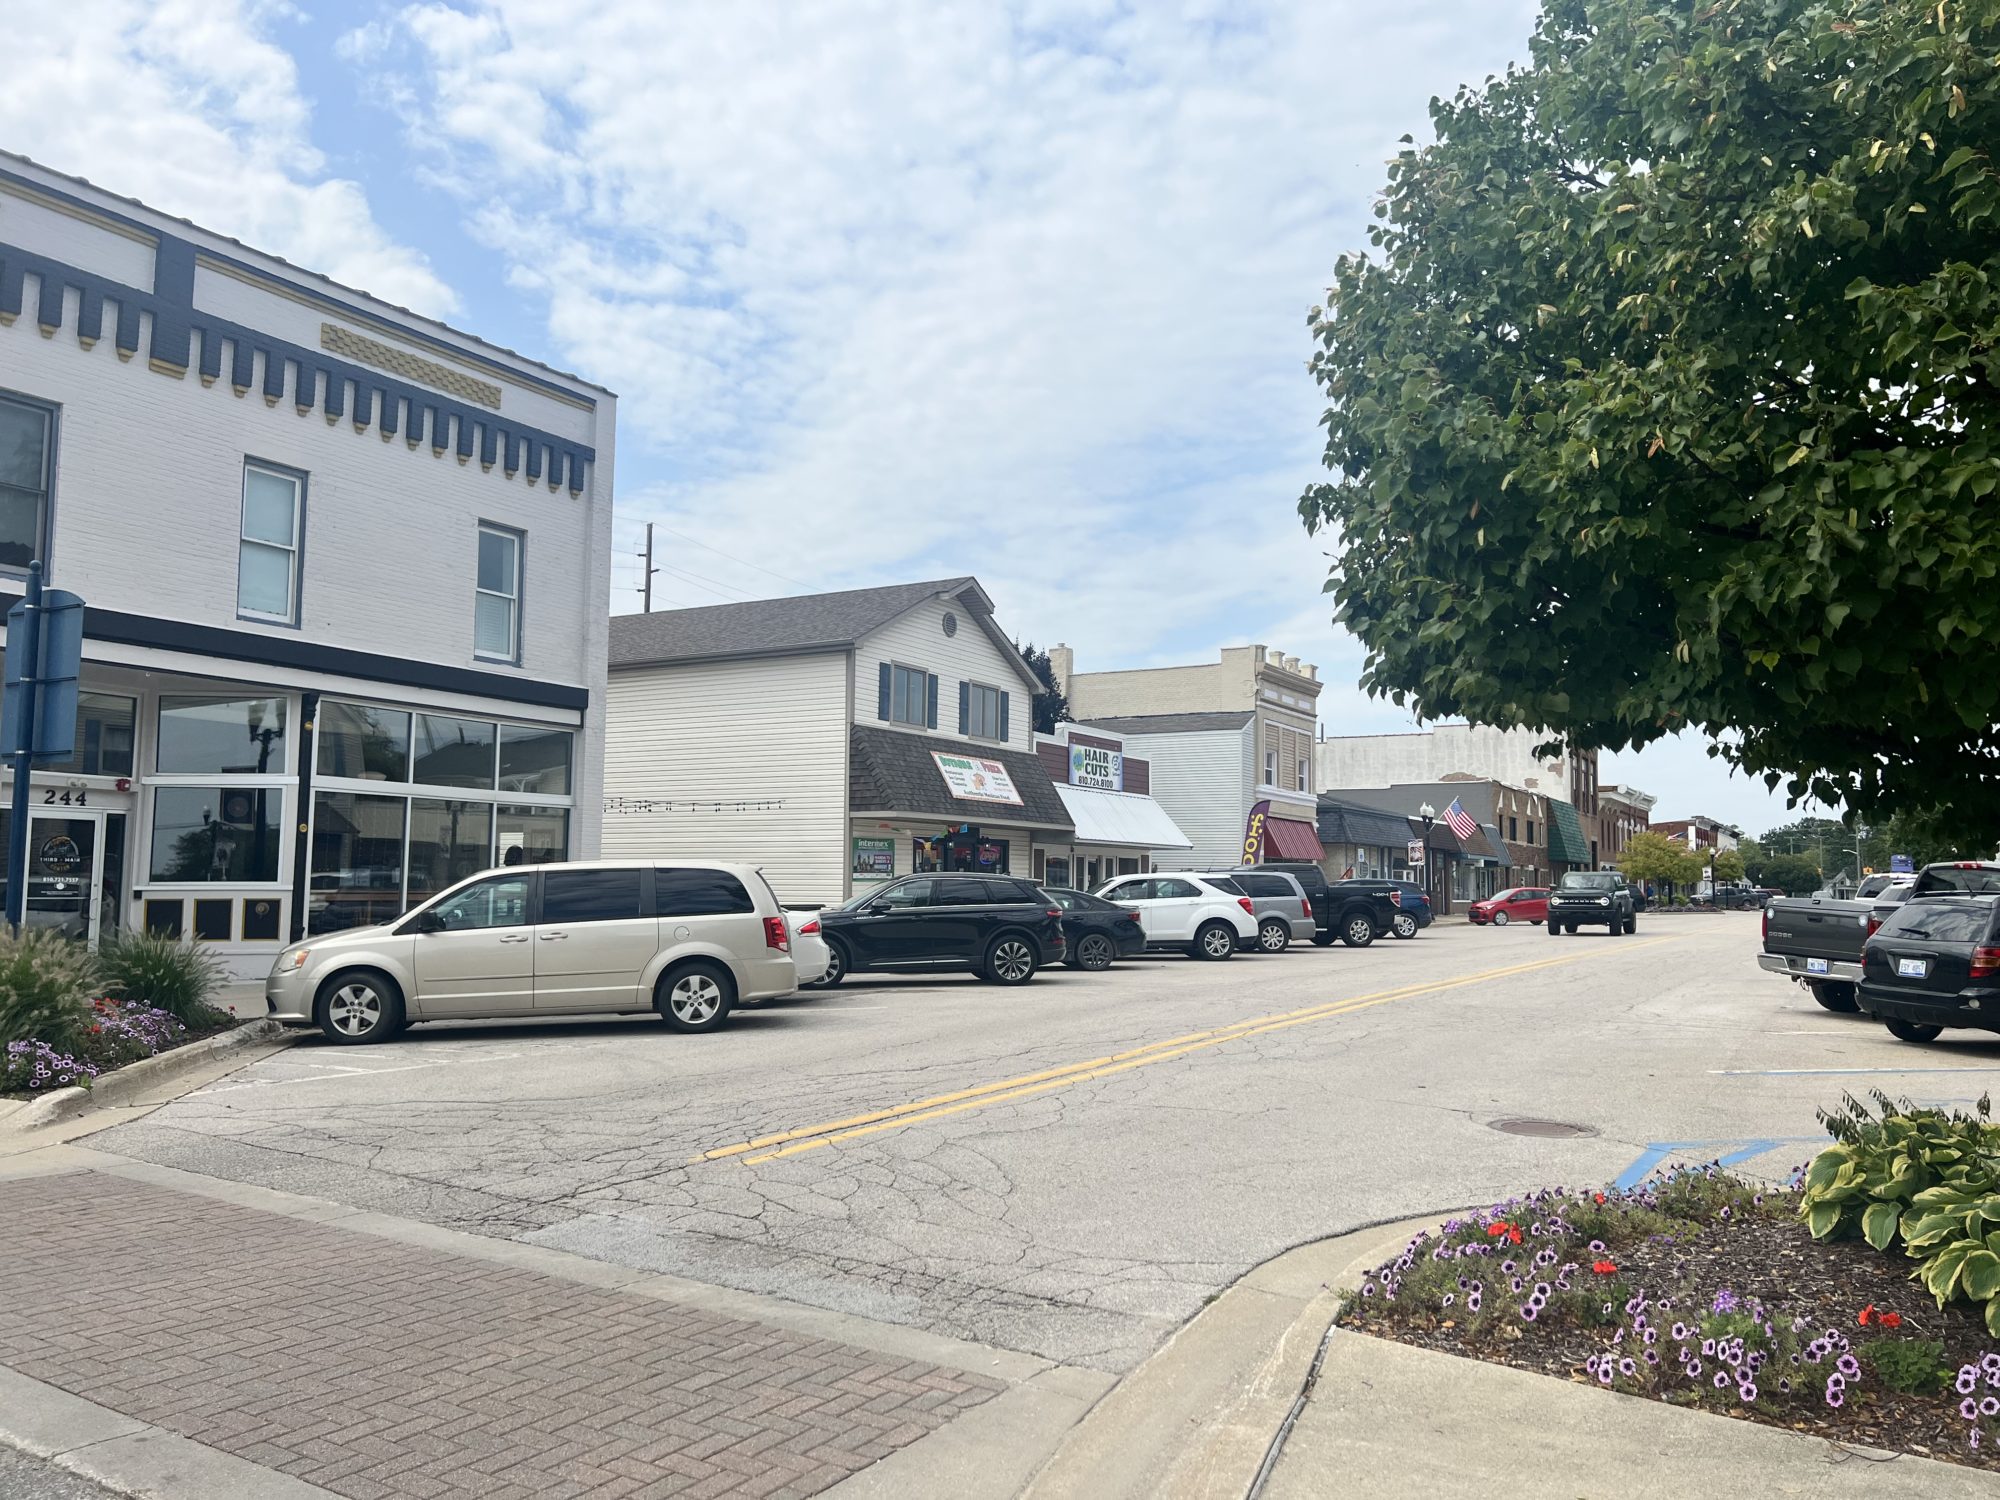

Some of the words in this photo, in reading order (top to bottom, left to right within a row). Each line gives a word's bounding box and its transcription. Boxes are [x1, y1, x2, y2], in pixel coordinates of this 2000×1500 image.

[1085, 749, 1109, 764] HAIR
[1085, 762, 1109, 777] CUTS
[1079, 776, 1113, 788] 810.724.8100
[44, 789, 87, 807] 244
[858, 839, 889, 847] intermex
